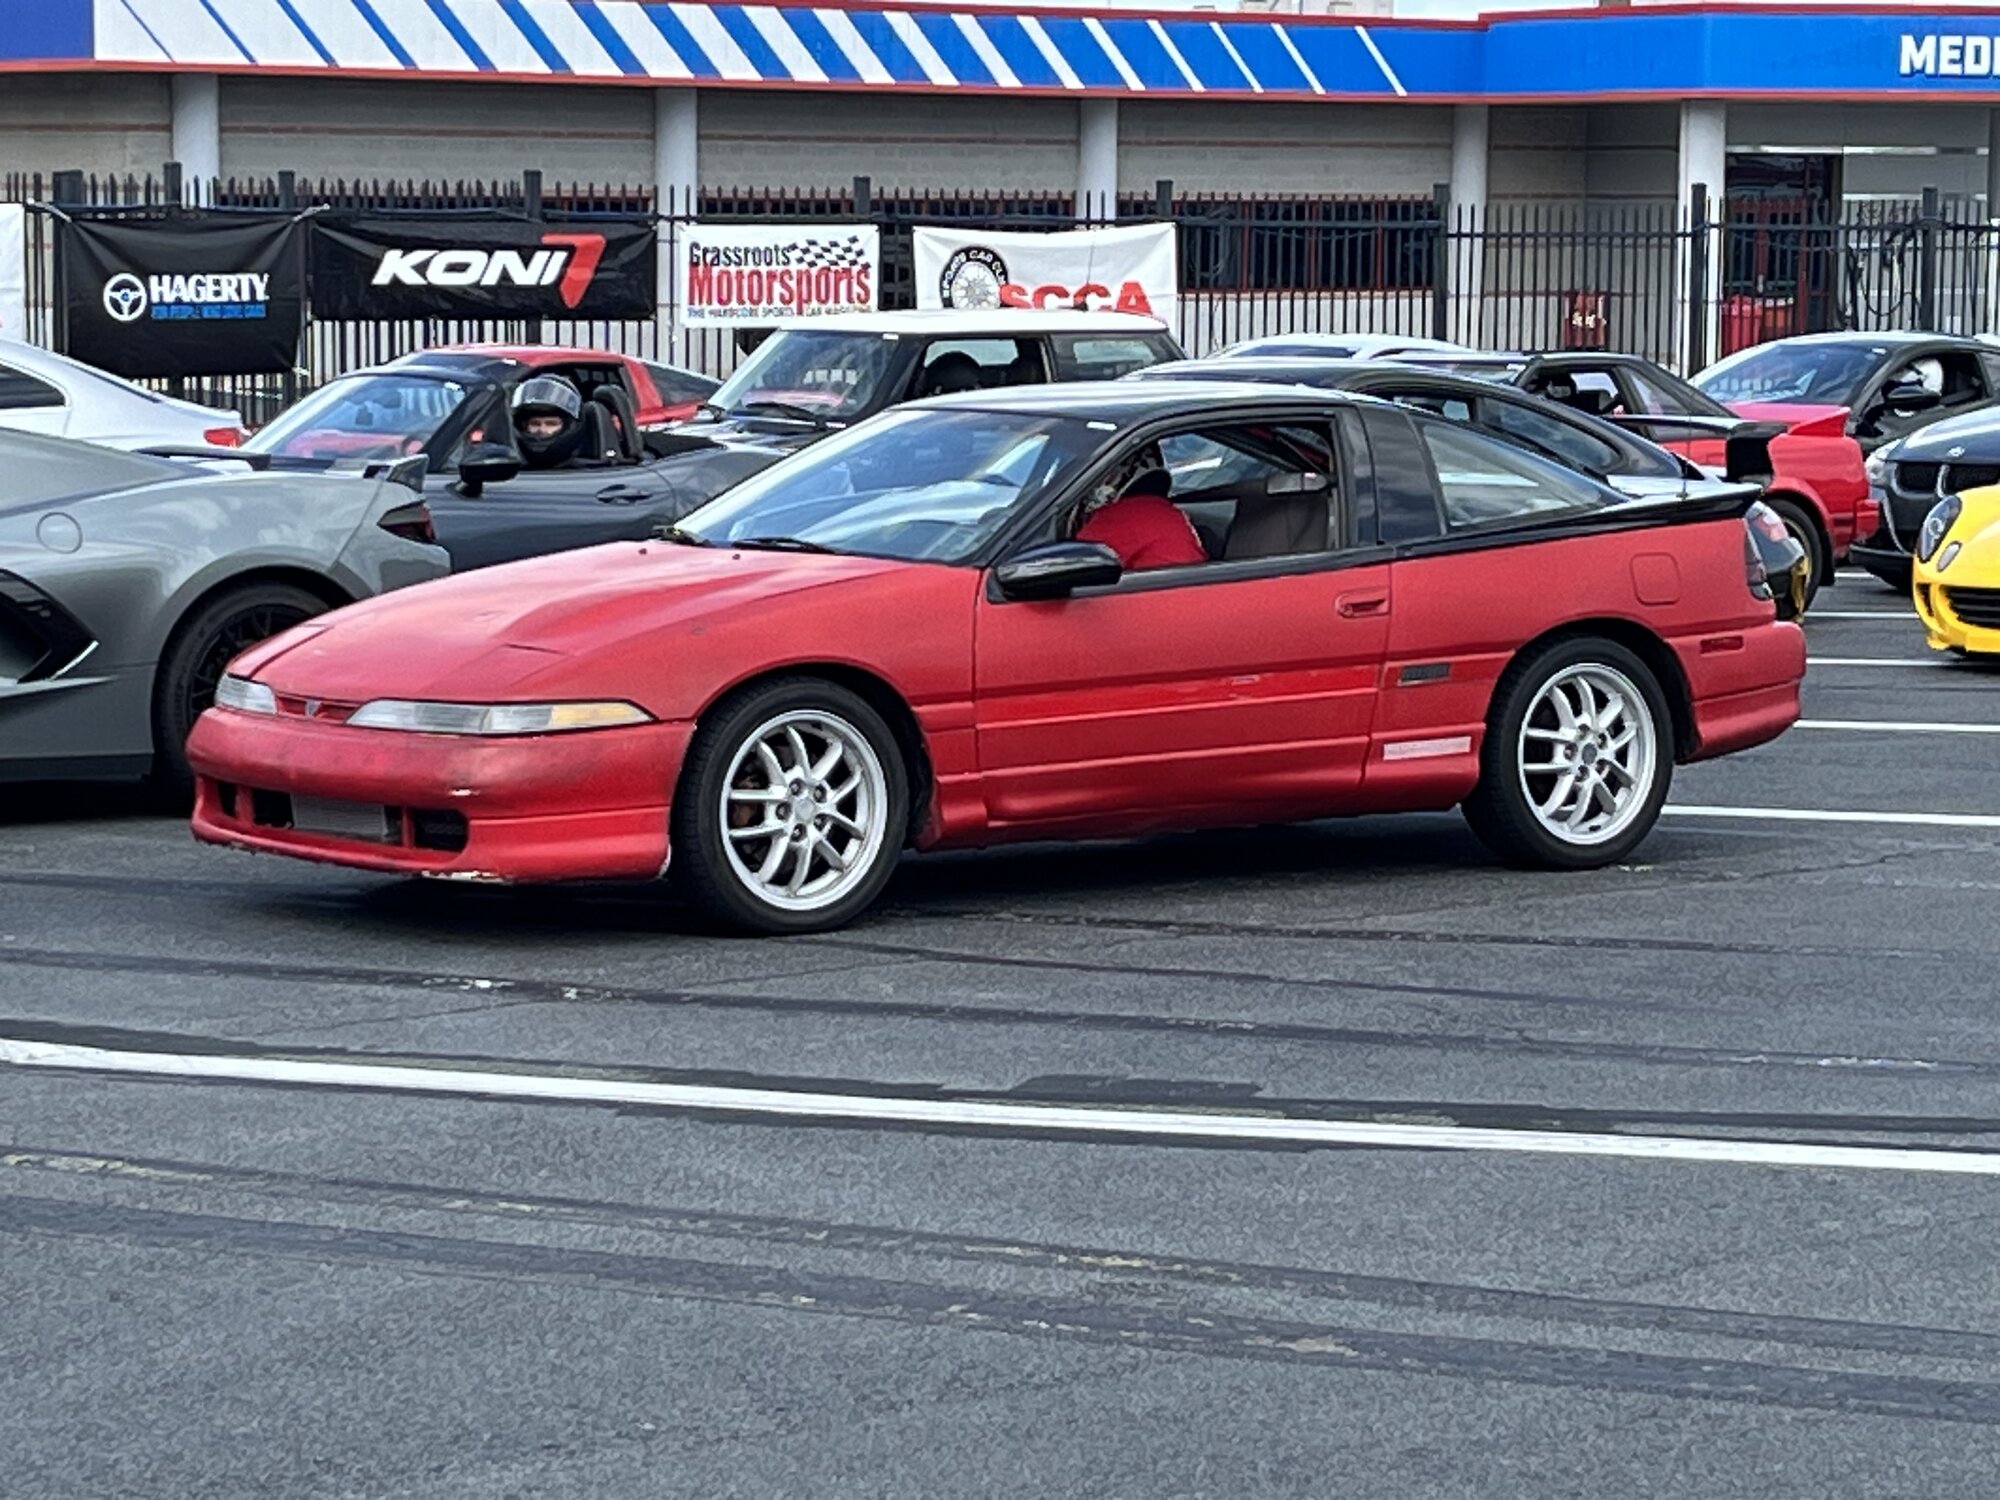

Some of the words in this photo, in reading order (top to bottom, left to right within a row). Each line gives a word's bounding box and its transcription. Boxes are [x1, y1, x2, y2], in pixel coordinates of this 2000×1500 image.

[689, 241, 791, 267] Grassroots
[149, 273, 269, 303] HAGERTY
[688, 264, 871, 316] Motorsports
